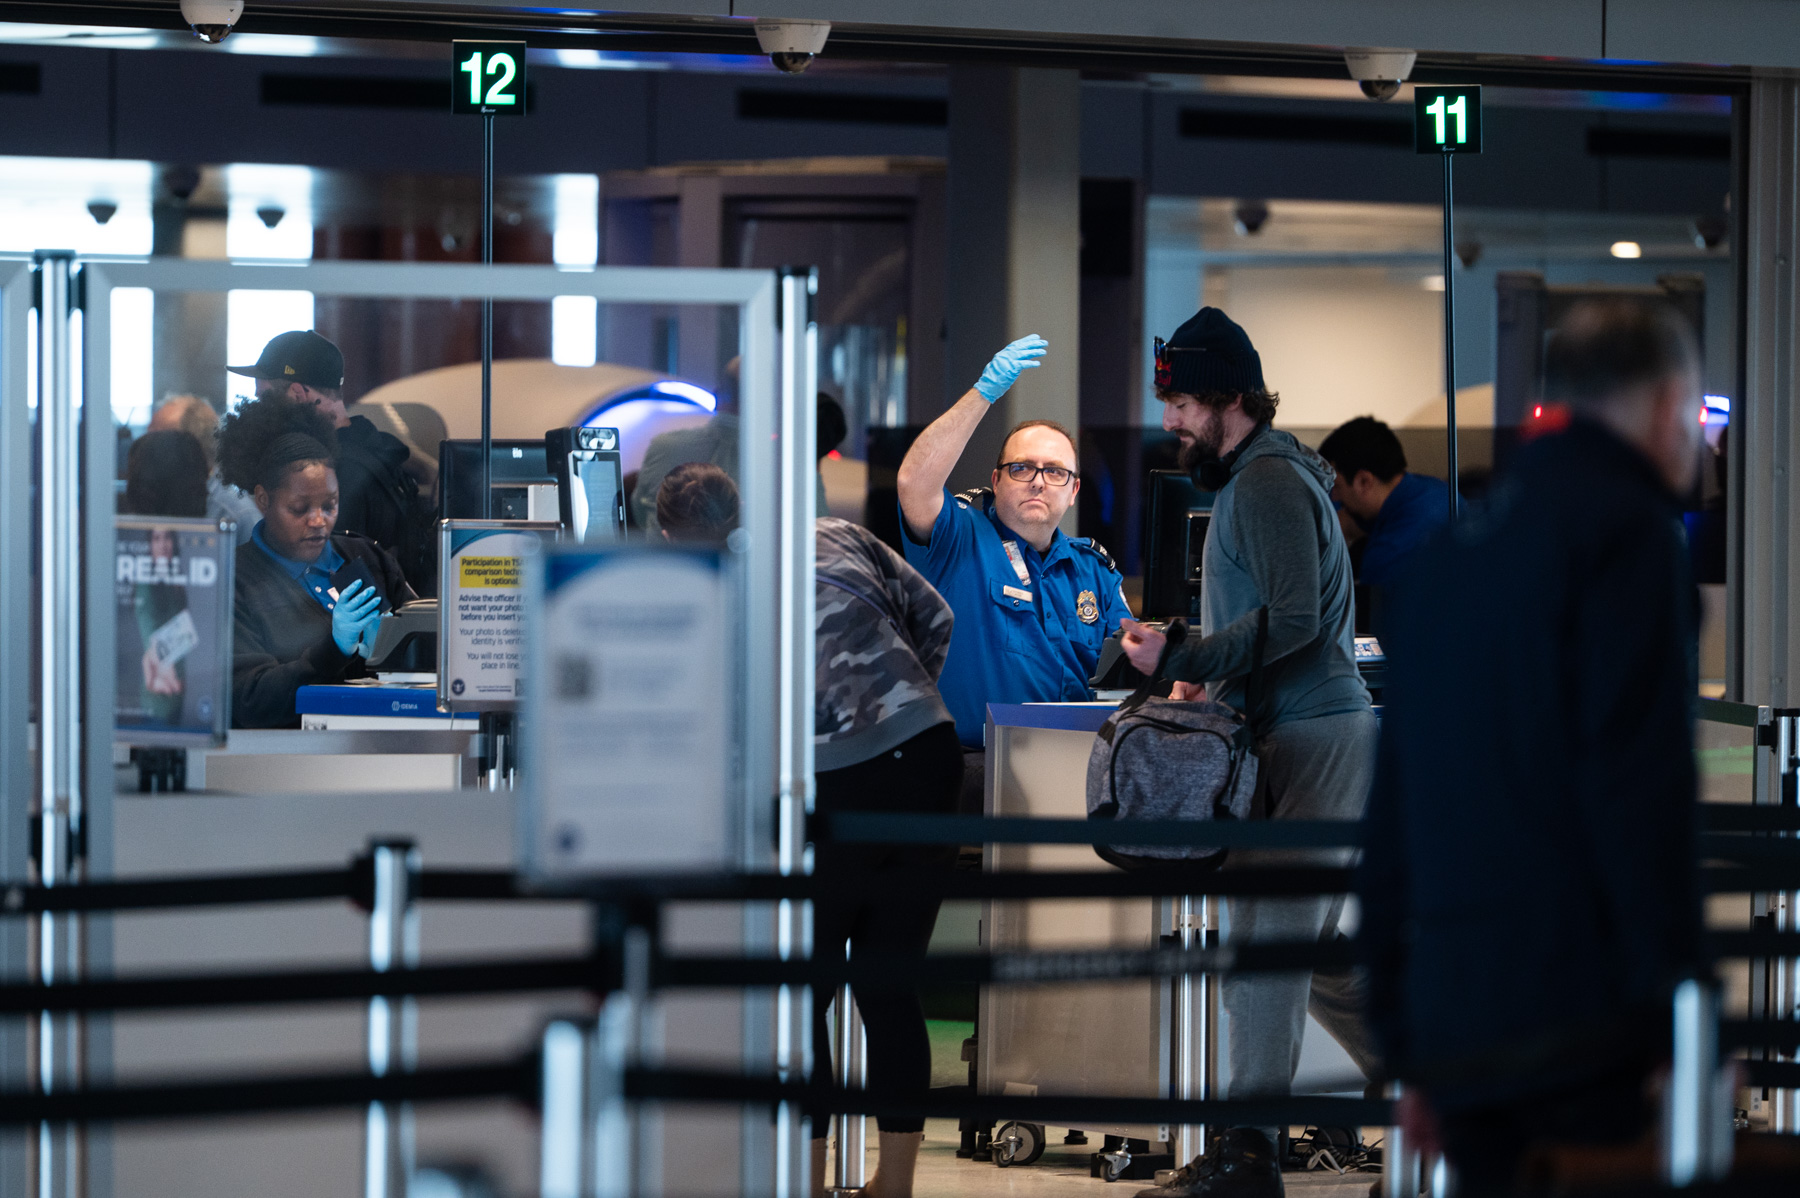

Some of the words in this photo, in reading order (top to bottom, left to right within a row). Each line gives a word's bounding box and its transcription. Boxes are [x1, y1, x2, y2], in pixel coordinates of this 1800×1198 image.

[460, 51, 516, 105] 12
[1425, 95, 1467, 145] 11
[462, 558, 503, 567] Participation
[504, 558, 511, 566] in
[116, 554, 187, 584] REAL
[189, 556, 218, 586] ID
[485, 577, 490, 585] is
[459, 594, 481, 602] Advise
[482, 594, 493, 602] the
[494, 594, 515, 602] officer
[488, 605, 503, 613] your
[483, 614, 496, 622] you
[475, 628, 495, 636] photo
[471, 637, 497, 646] identity
[467, 652, 479, 660] You
[480, 651, 492, 660] will
[493, 652, 504, 660] not
[505, 652, 519, 660] lose
[481, 662, 498, 670] place
